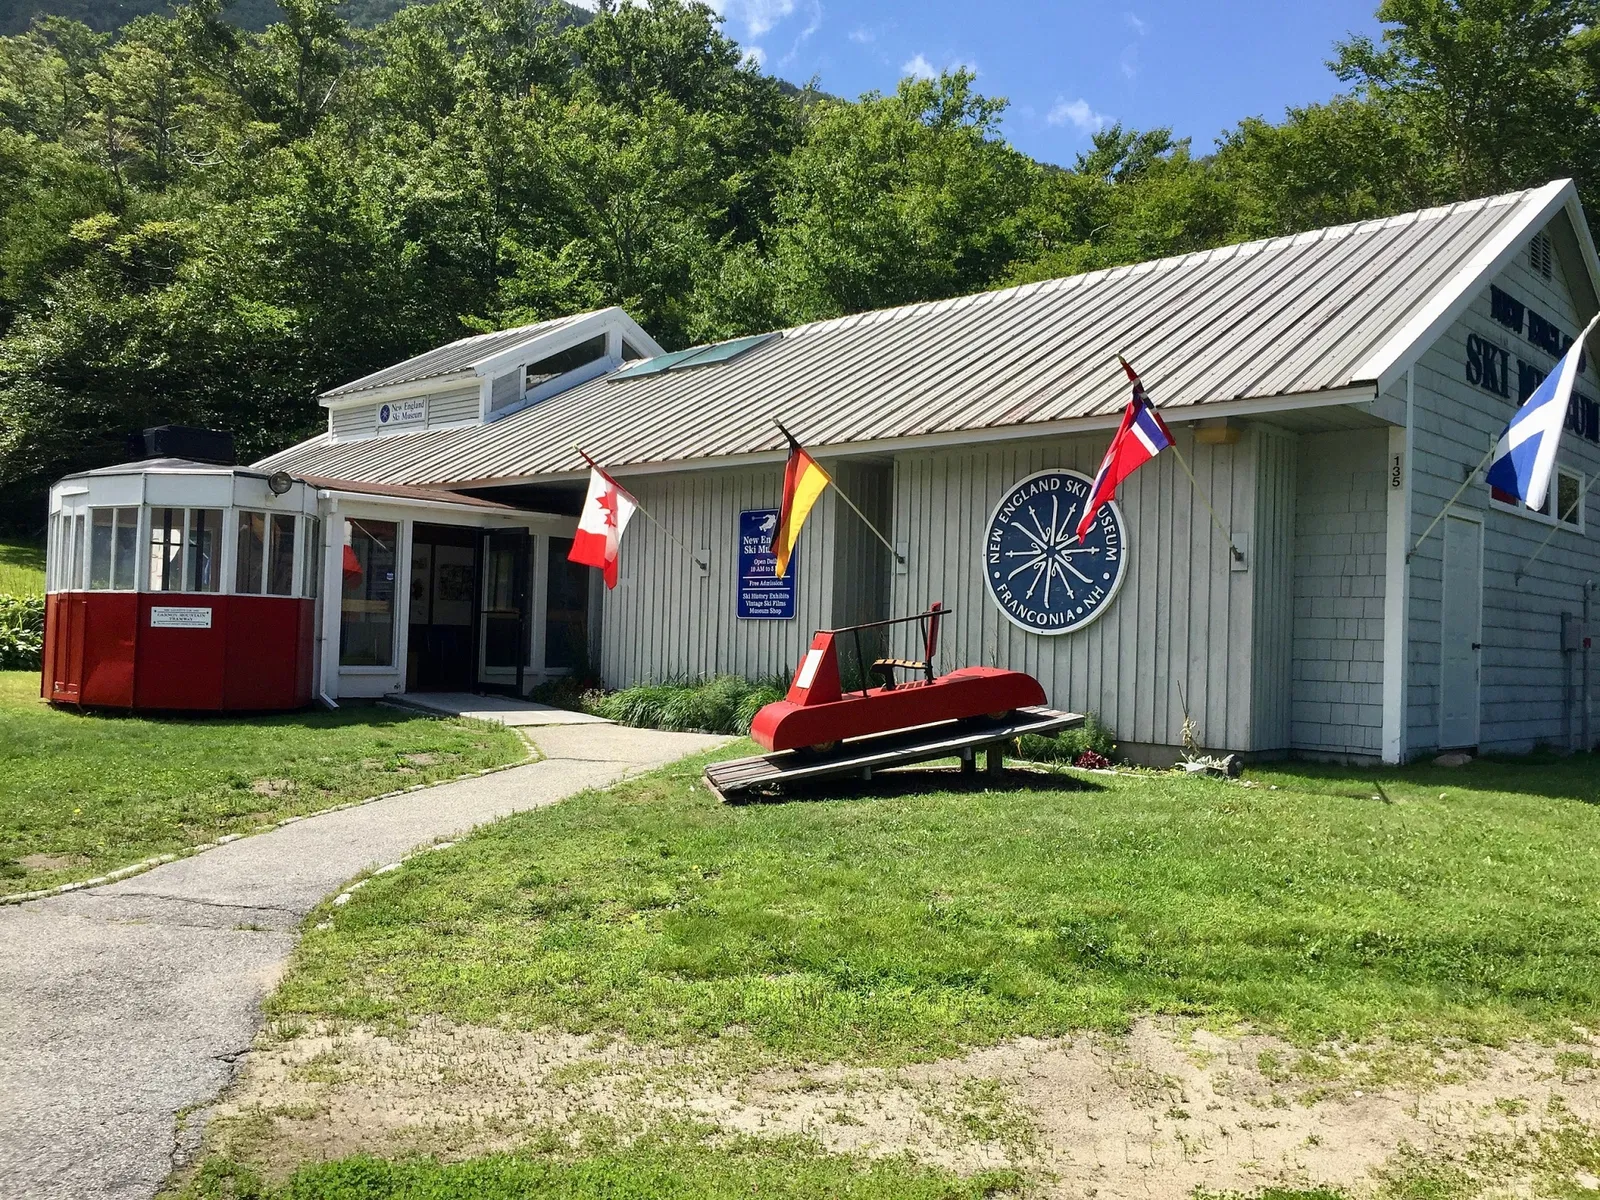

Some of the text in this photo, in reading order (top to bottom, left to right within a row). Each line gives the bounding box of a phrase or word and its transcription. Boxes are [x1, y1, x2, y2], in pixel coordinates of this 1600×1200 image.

[1466, 333, 1510, 399] SKI
[392, 399, 425, 412] New England
[392, 411, 422, 421] Ski Museum
[1392, 456, 1401, 487] 135
[989, 478, 1118, 563] NEW ENGLAND SKI USEUM
[743, 536, 759, 545] New
[743, 545, 756, 554] Ski
[997, 583, 1105, 625] FRANCONIA NH
[770, 607, 782, 615] Shop
